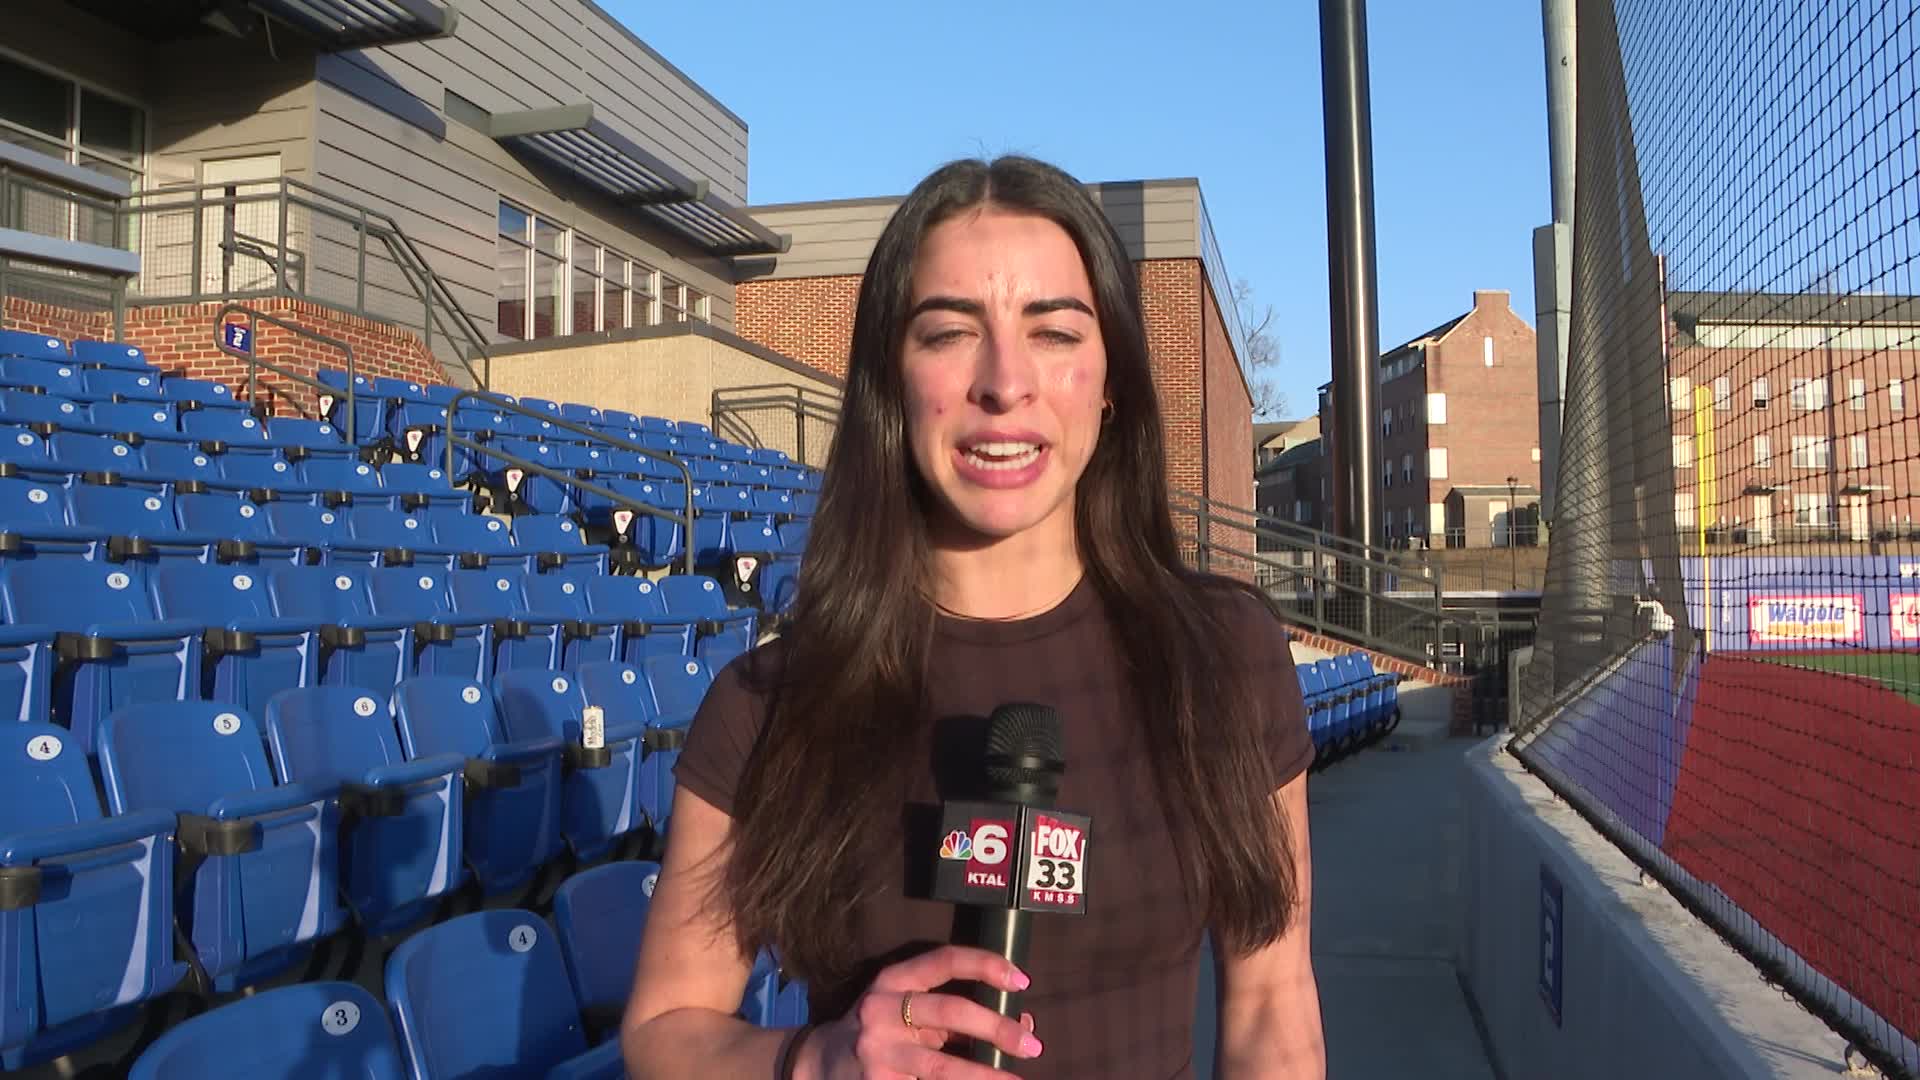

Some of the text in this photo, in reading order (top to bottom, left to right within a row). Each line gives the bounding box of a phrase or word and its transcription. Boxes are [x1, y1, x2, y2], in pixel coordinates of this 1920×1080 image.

[1768, 603, 1845, 626] Walpole
[39, 741, 50, 754] 4
[972, 824, 1009, 865] 6
[1037, 824, 1080, 860] FOX
[967, 872, 1006, 887] KTAL
[1035, 858, 1076, 890] 33
[518, 930, 528, 946] 4
[335, 1008, 348, 1026] 3
